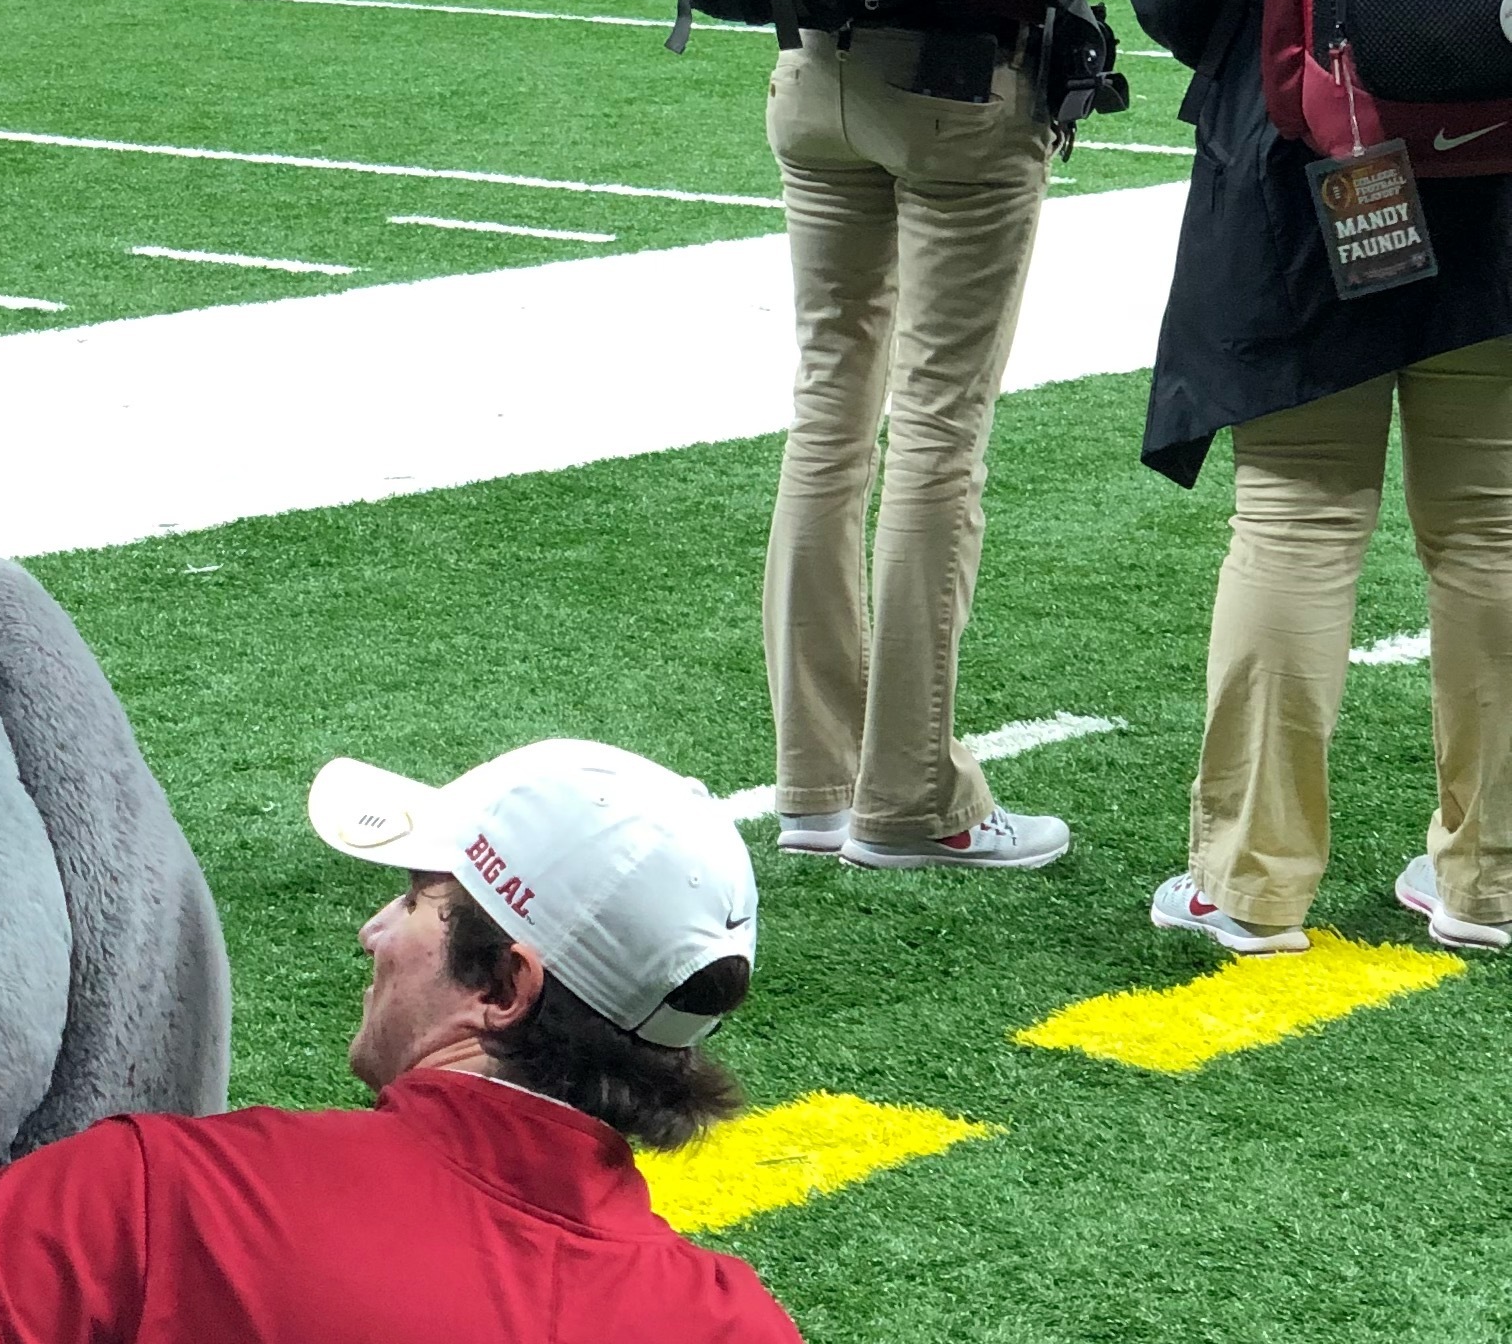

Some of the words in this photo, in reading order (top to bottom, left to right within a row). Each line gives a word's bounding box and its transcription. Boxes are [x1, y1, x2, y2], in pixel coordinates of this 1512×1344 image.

[1335, 203, 1408, 239] MANDY
[1338, 227, 1421, 264] FAUNDA
[464, 833, 507, 885] BIG
[495, 876, 536, 918] AL
